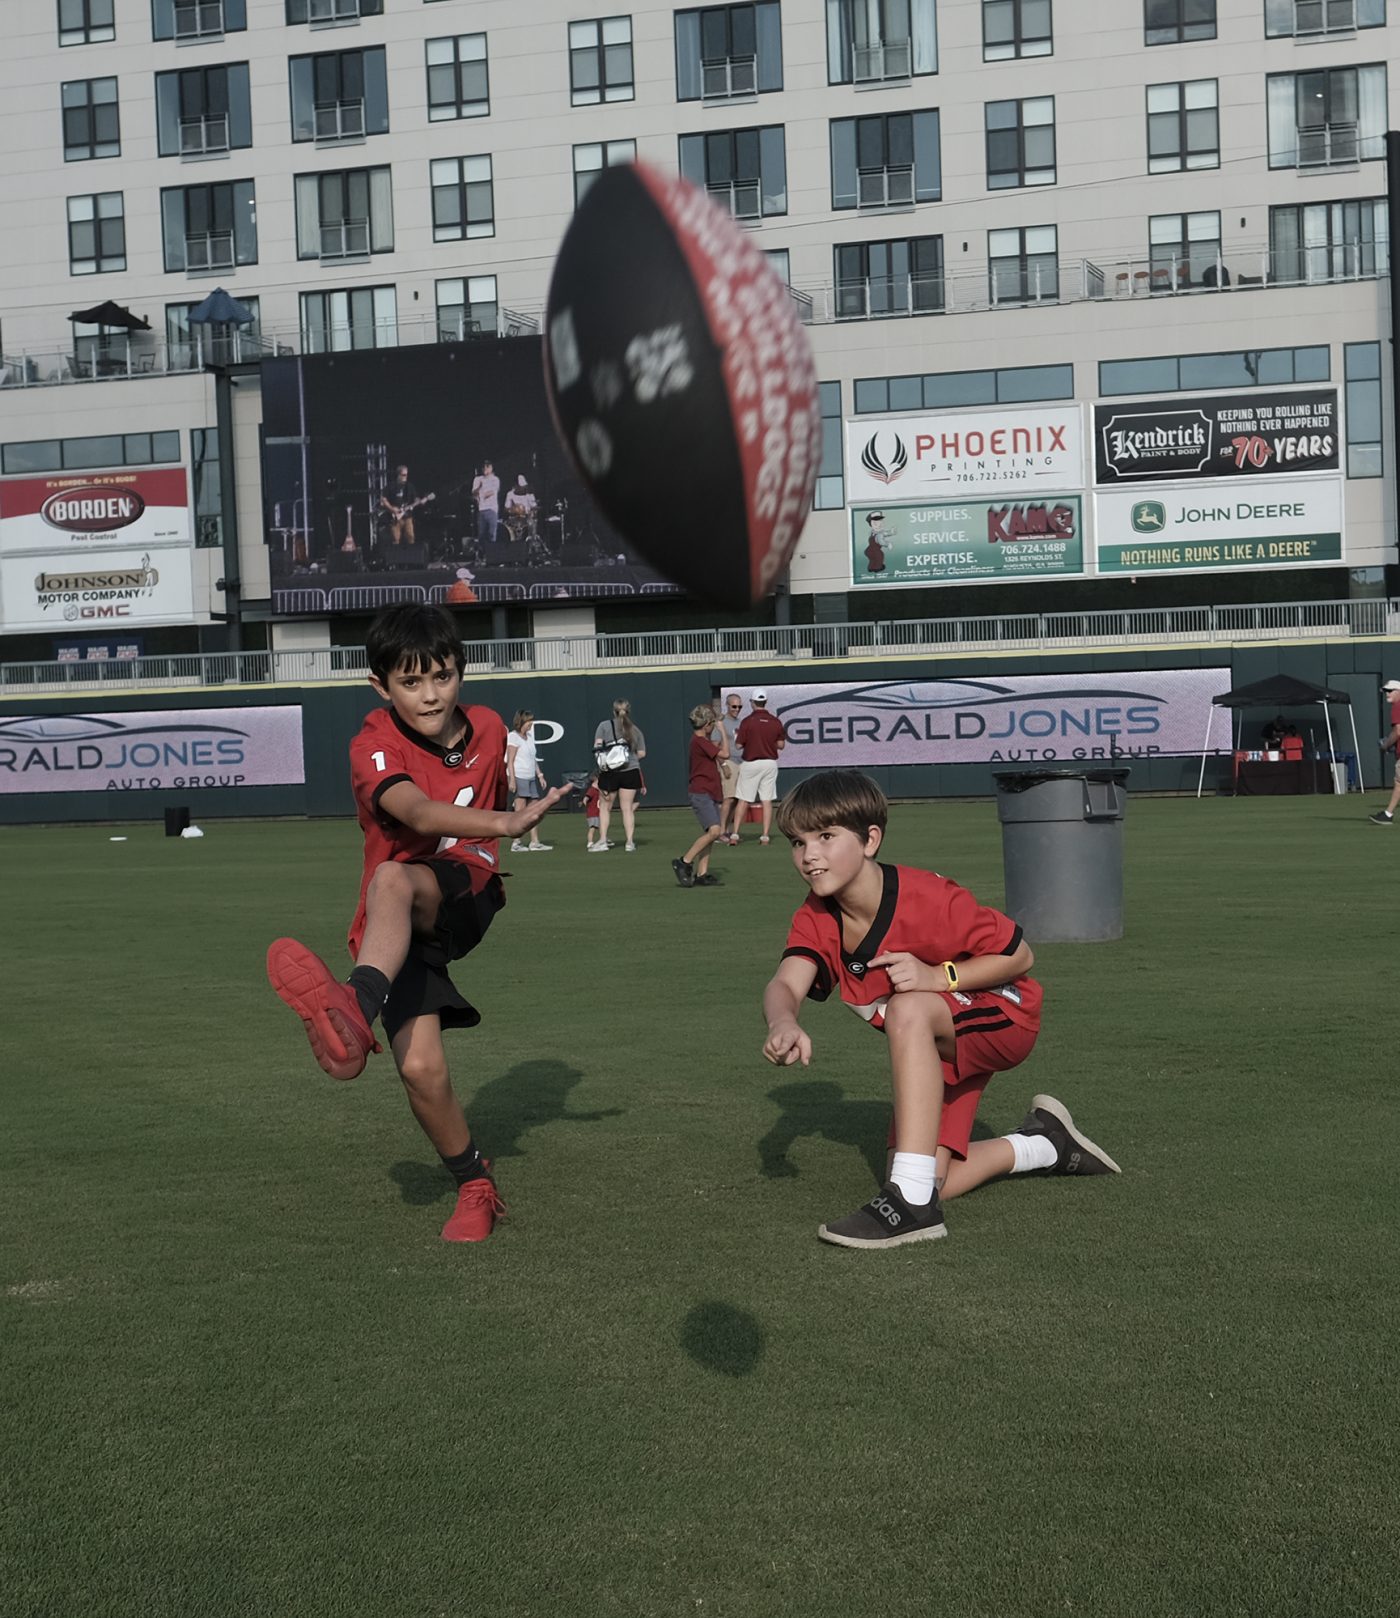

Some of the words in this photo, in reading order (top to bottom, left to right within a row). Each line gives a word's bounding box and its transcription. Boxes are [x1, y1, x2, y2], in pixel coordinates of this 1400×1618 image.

[1217, 409, 1253, 421] KEEPING
[1256, 408, 1273, 419] YOU
[1275, 405, 1311, 418] ROLLING
[1313, 403, 1332, 415] LIKE
[1220, 420, 1257, 433] NOTHING
[1260, 419, 1281, 432] EVER
[1284, 416, 1330, 430] HAPPENED
[915, 425, 1067, 460] PHOENIX
[1110, 423, 1206, 461] Kendrick
[1219, 446, 1233, 455] FOR
[1273, 435, 1334, 464] YEARS
[1140, 449, 1168, 458] PAINT
[1178, 447, 1201, 456] BODY
[931, 456, 1053, 472] PRINTING
[956, 470, 1027, 482] 706.722.5262
[55, 497, 131, 521] BORDEN
[909, 508, 972, 524] SUPPLIES.
[1174, 506, 1231, 524] JOHN
[1236, 503, 1306, 520] DEERE
[90, 532, 118, 541] Control
[913, 530, 970, 545] SERVICE.
[1000, 542, 1067, 555] 706.724.1488
[1120, 548, 1181, 566] NOTHING
[1184, 545, 1220, 562] RUNS
[1224, 543, 1253, 560] LIKE
[1256, 543, 1266, 559] A
[906, 551, 978, 567] EXPERTISE.
[893, 566, 931, 578] Products
[931, 565, 945, 576] for
[947, 564, 996, 576] Cleanliness
[36, 572, 141, 592] JOHNSON
[38, 592, 79, 604] MOTOR
[82, 589, 141, 601] COMPANY
[80, 604, 131, 619] GMC
[784, 711, 987, 745] GERALD
[987, 705, 1161, 739] JONES
[104, 739, 245, 769] JONES
[370, 750, 387, 772] 1
[989, 748, 1058, 762] AUTO
[1071, 744, 1162, 760] GROUP
[106, 777, 161, 791] AUTO
[173, 775, 246, 788] GROUP
